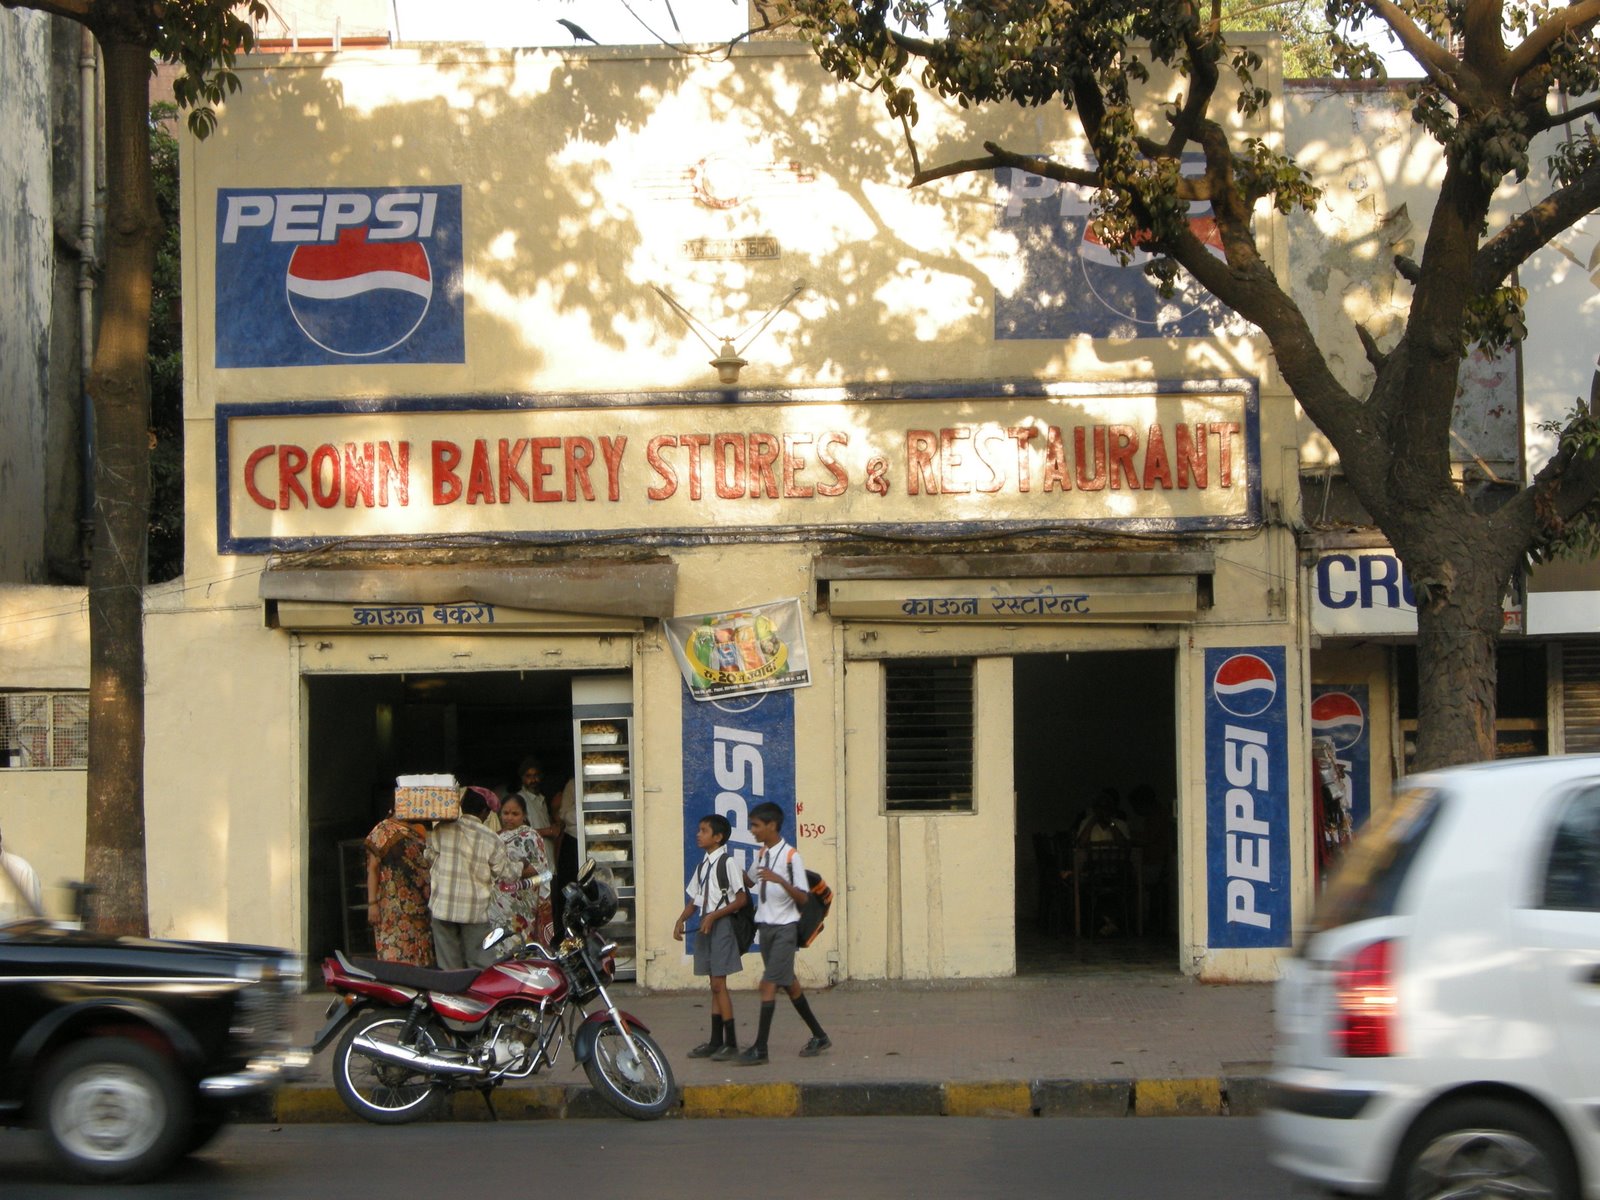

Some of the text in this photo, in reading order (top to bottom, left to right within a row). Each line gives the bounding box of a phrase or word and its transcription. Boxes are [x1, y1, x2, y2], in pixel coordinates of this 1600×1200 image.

[222, 192, 438, 243] PEPSI
[244, 421, 1240, 510] CROWN BAKERY STORES & RESTAURANT
[1317, 554, 1418, 609] CR
[714, 725, 765, 944] PSI
[800, 823, 826, 839] 1330
[1225, 724, 1272, 929] PEPSI
